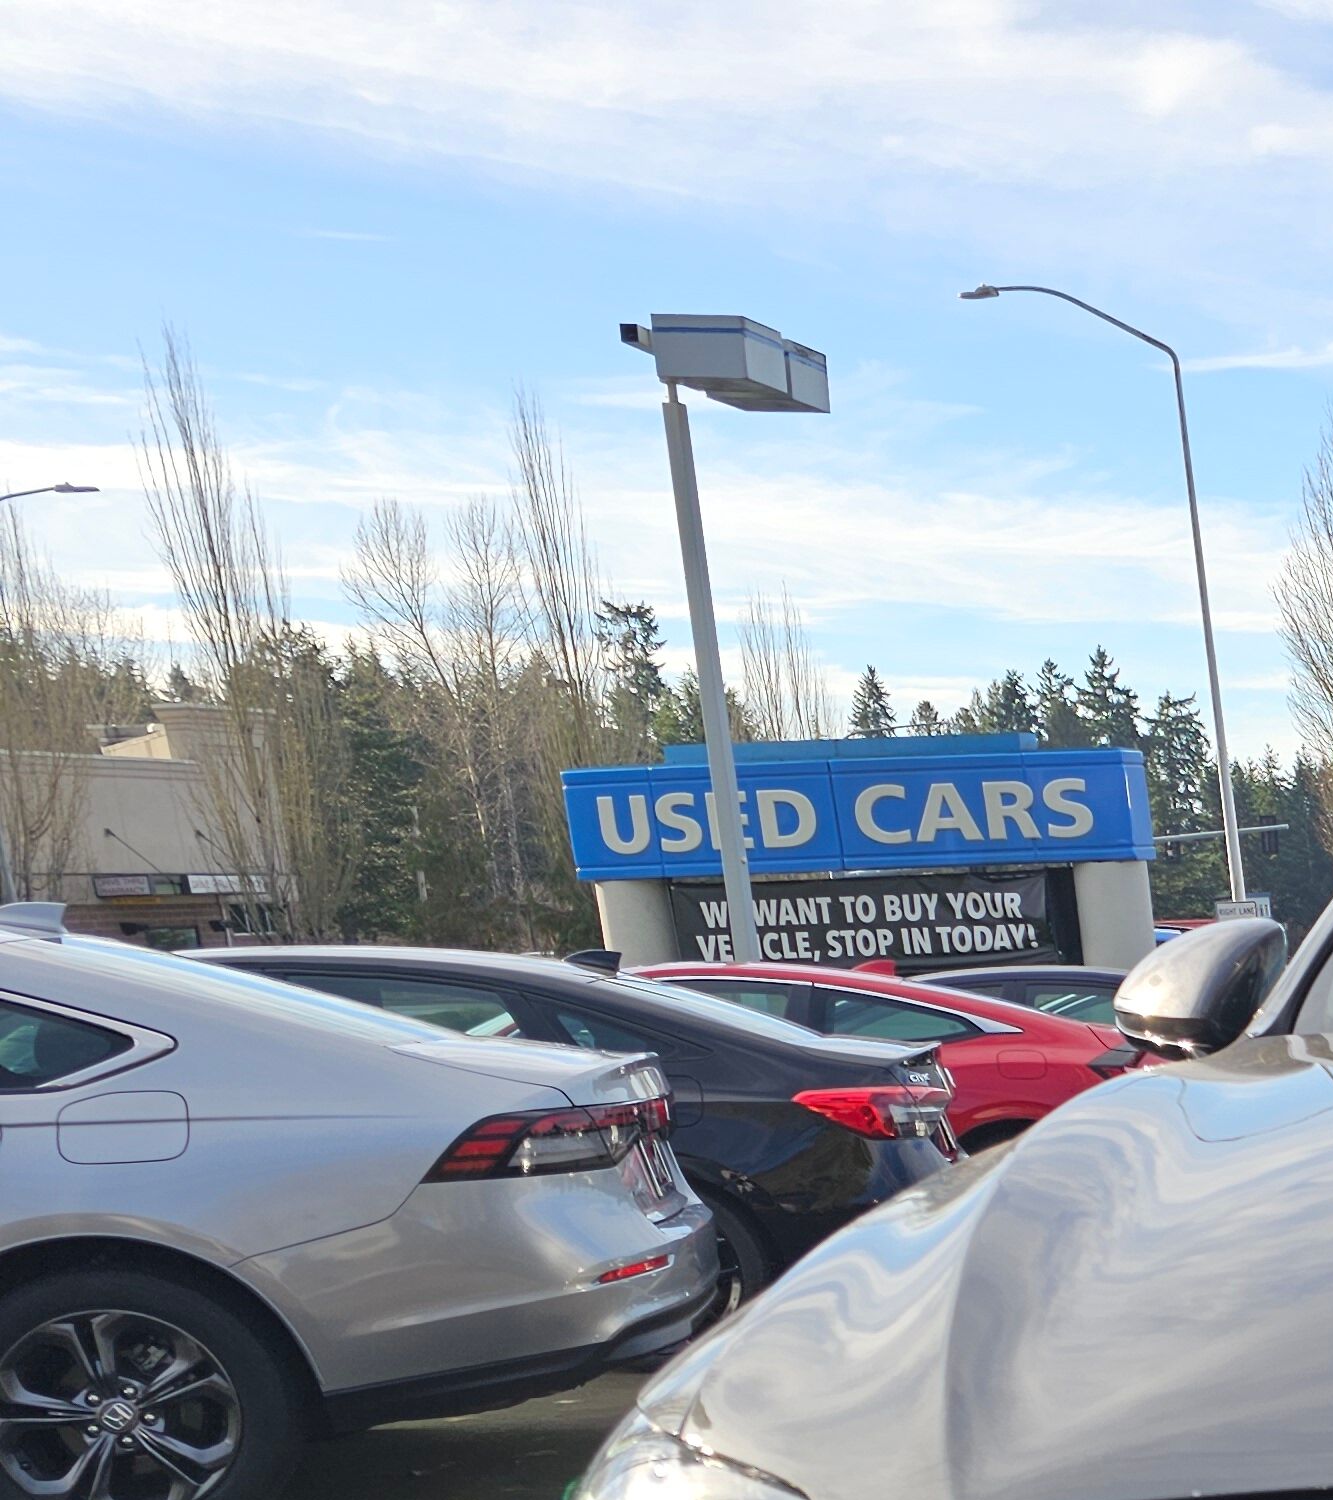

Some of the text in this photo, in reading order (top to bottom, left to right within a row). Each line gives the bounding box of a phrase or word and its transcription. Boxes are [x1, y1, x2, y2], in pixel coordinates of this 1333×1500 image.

[596, 778, 1094, 854] USED CARS
[700, 892, 1023, 929] W WANT TO BUY YOUR
[696, 923, 1039, 963] VEICLE, STOP IN TODAY!
